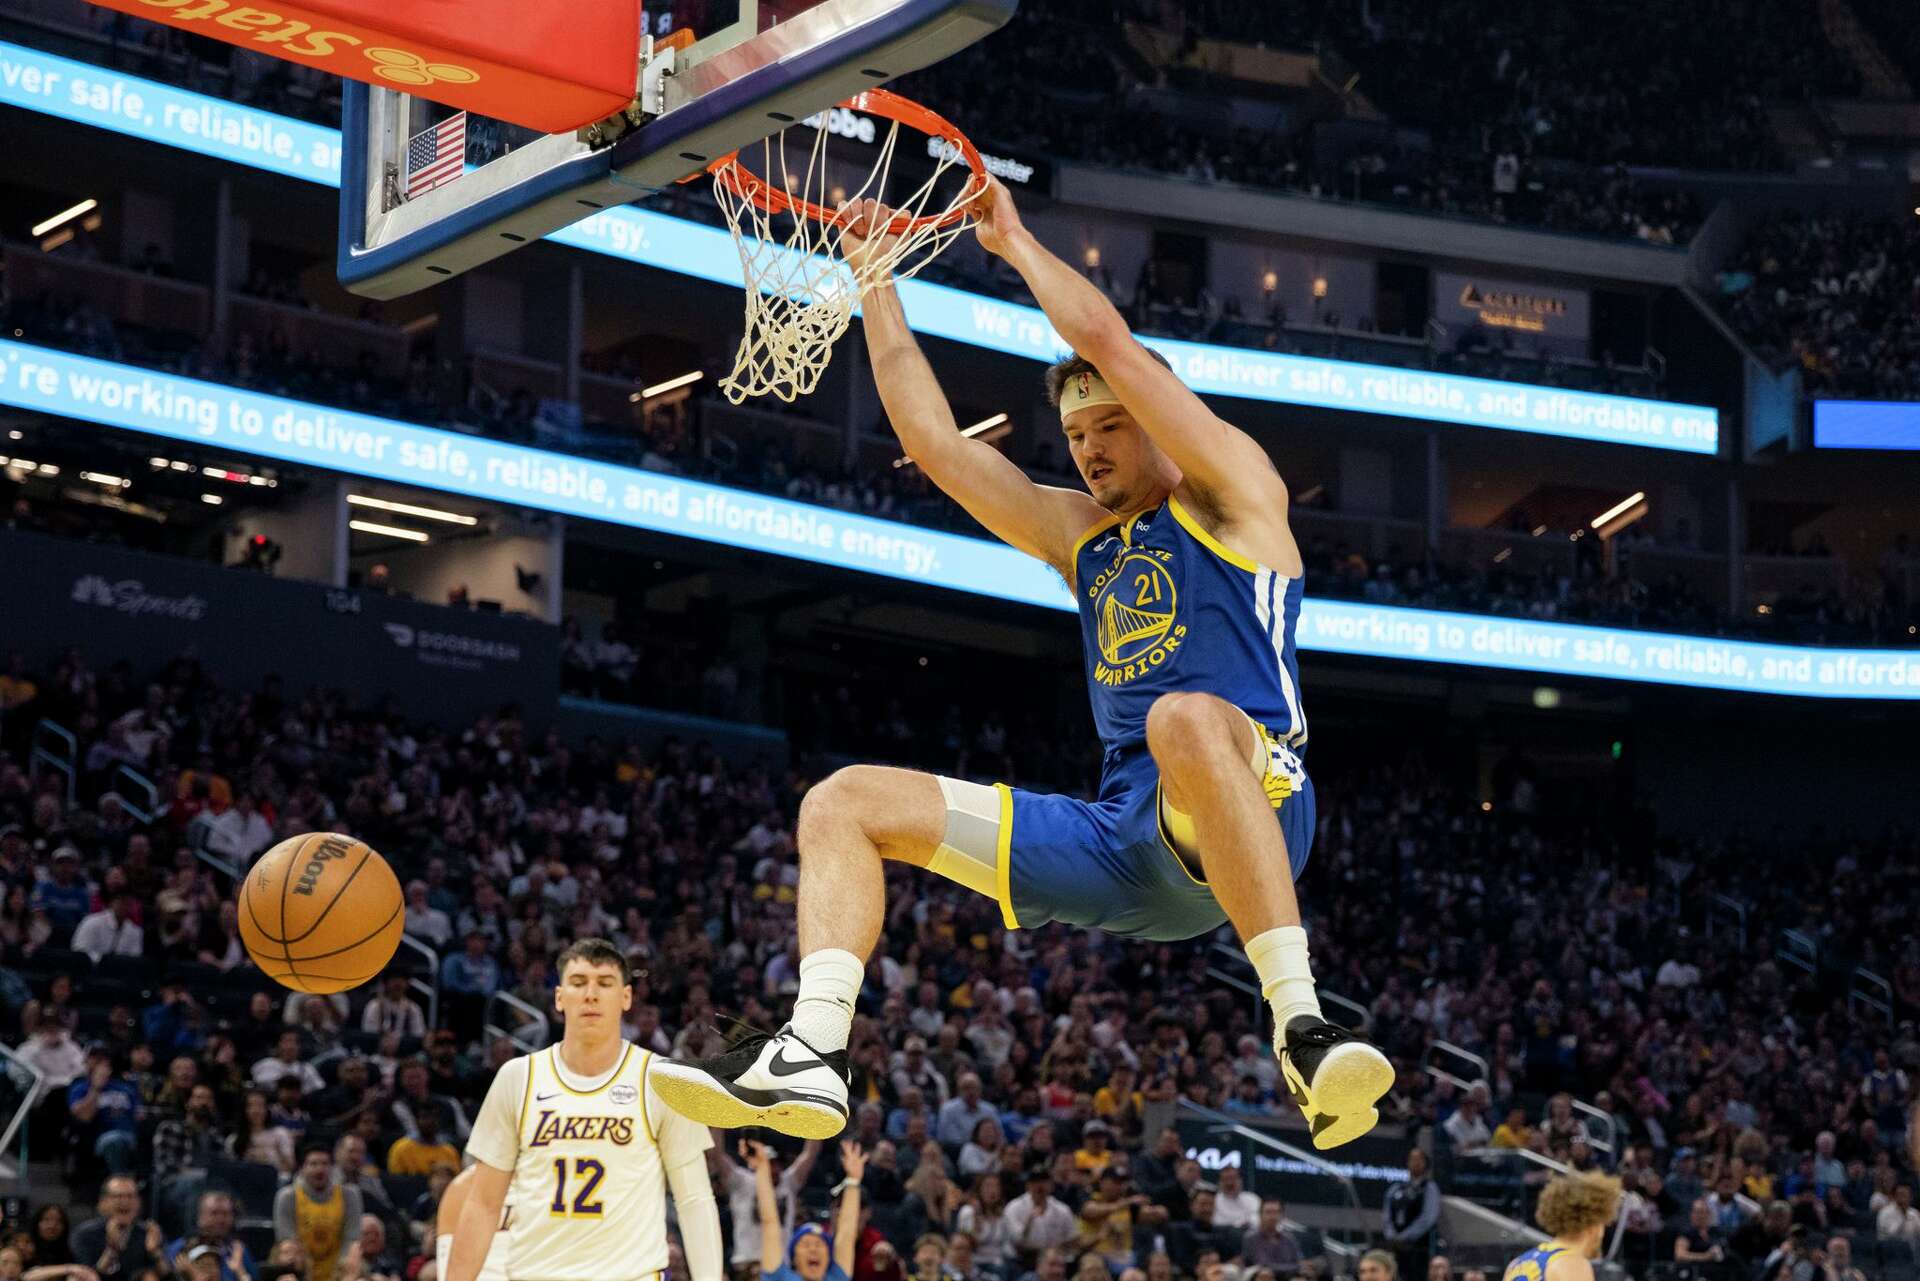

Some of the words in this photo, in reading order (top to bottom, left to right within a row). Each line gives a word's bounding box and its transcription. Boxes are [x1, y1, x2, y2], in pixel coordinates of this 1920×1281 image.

[70, 78, 154, 126] safe,
[163, 103, 302, 165] reliable,
[581, 216, 650, 253] ergy.
[971, 301, 1042, 345] We're
[1187, 353, 1284, 387] deliver
[1290, 368, 1355, 400] safe,
[1361, 373, 1472, 413] reliable,
[1478, 391, 1527, 417] and
[1533, 397, 1665, 436] affordable
[0, 350, 60, 396] 're
[68, 370, 219, 436] working
[228, 400, 263, 436] to
[272, 410, 392, 460] deliver
[398, 440, 477, 483] safe,
[486, 453, 615, 508] reliable,
[623, 483, 681, 518] and
[687, 495, 834, 549] affordable
[840, 527, 941, 575] energy.
[1134, 570, 1162, 607] 21
[1094, 624, 1187, 687] WARRIORS
[1314, 611, 1430, 653] working
[1437, 623, 1465, 648] to
[1471, 624, 1567, 659] deliver
[1573, 636, 1638, 670] safe,
[1645, 643, 1755, 681] reliable,
[1761, 655, 1811, 683] and
[528, 1109, 634, 1147] LAKERS
[550, 1156, 605, 1219] 12
